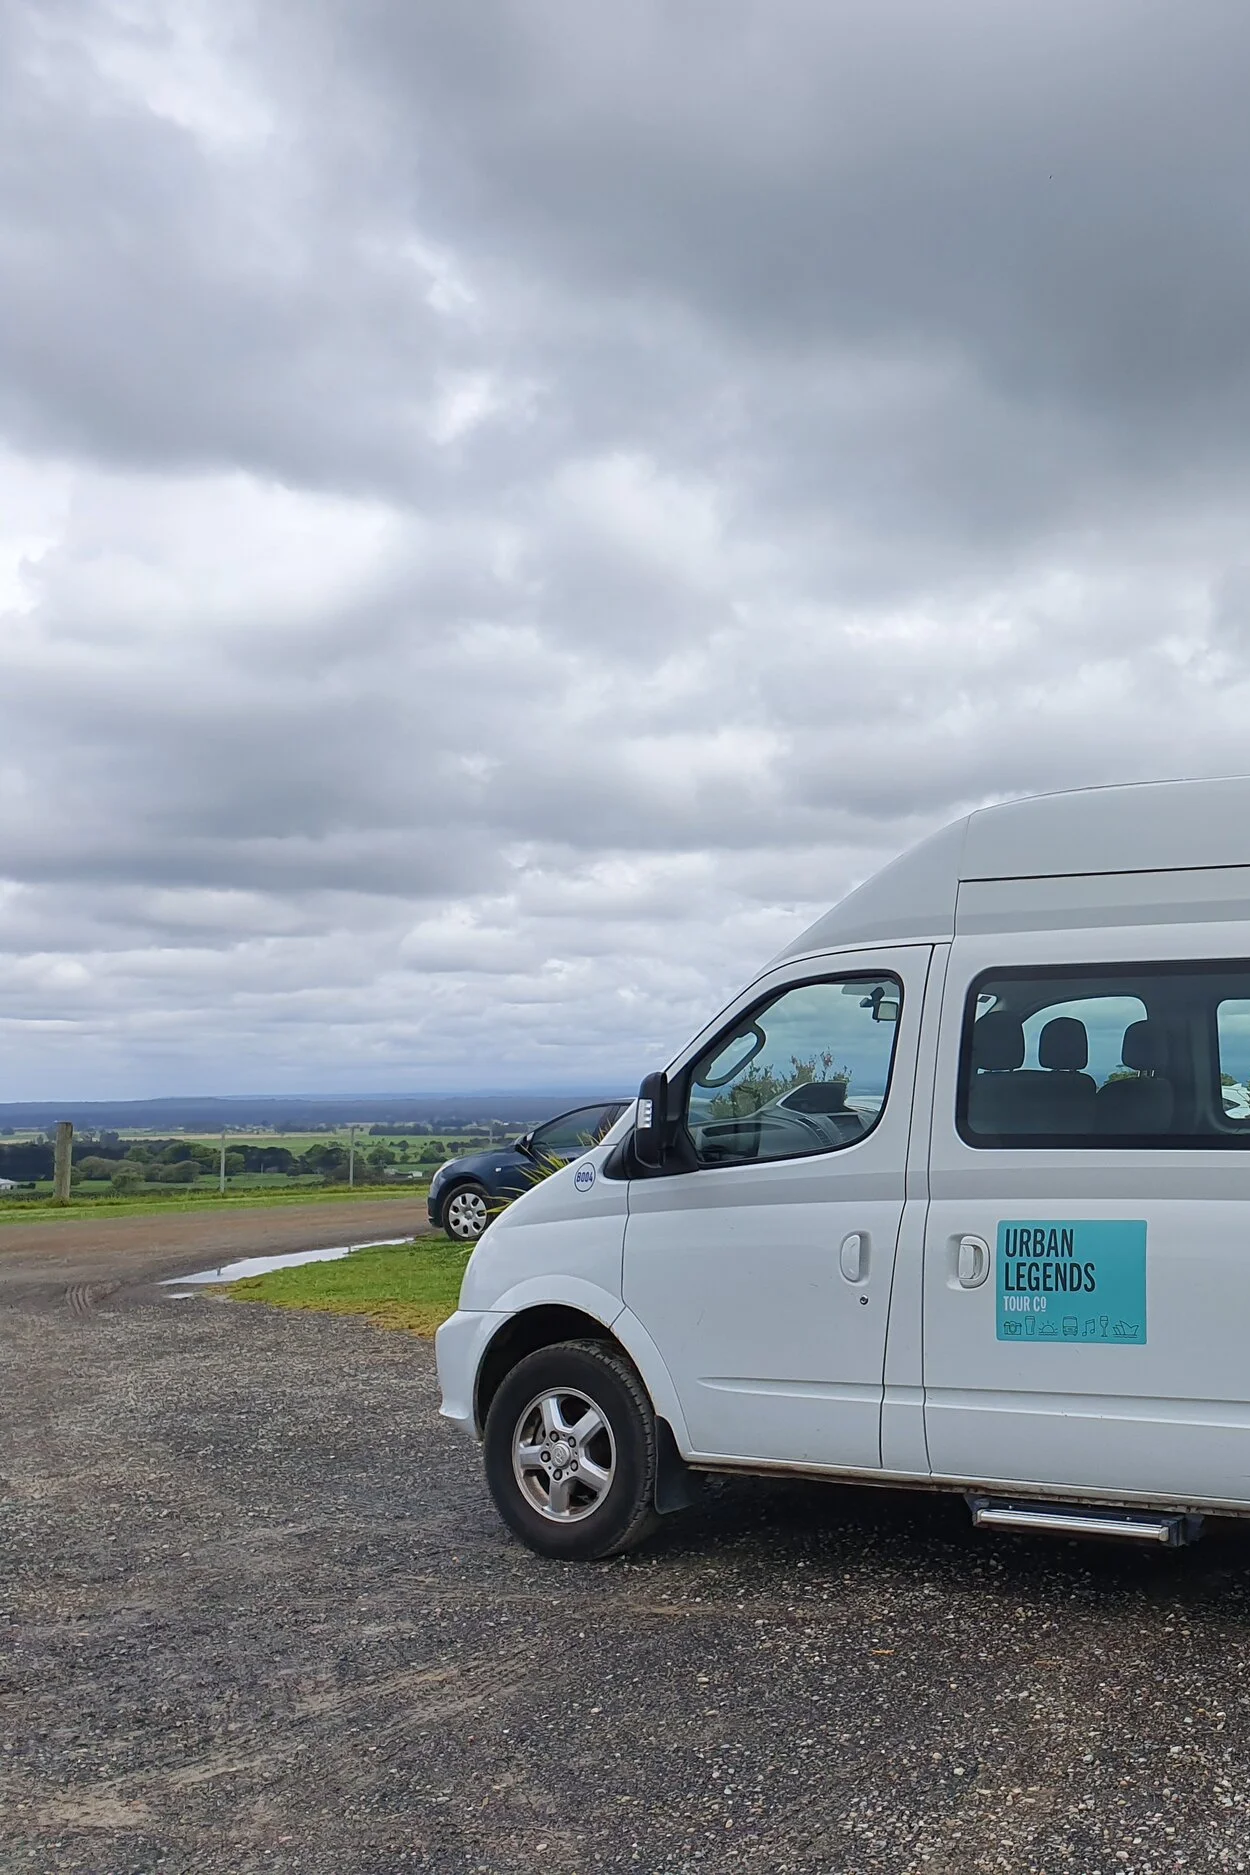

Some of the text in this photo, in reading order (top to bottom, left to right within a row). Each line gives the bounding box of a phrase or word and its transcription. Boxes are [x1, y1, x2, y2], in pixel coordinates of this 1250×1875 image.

[1005, 1228, 1074, 1258] URBAN
[1004, 1262, 1096, 1292] LEGENDS
[1003, 1296, 1031, 1312] TOUR
